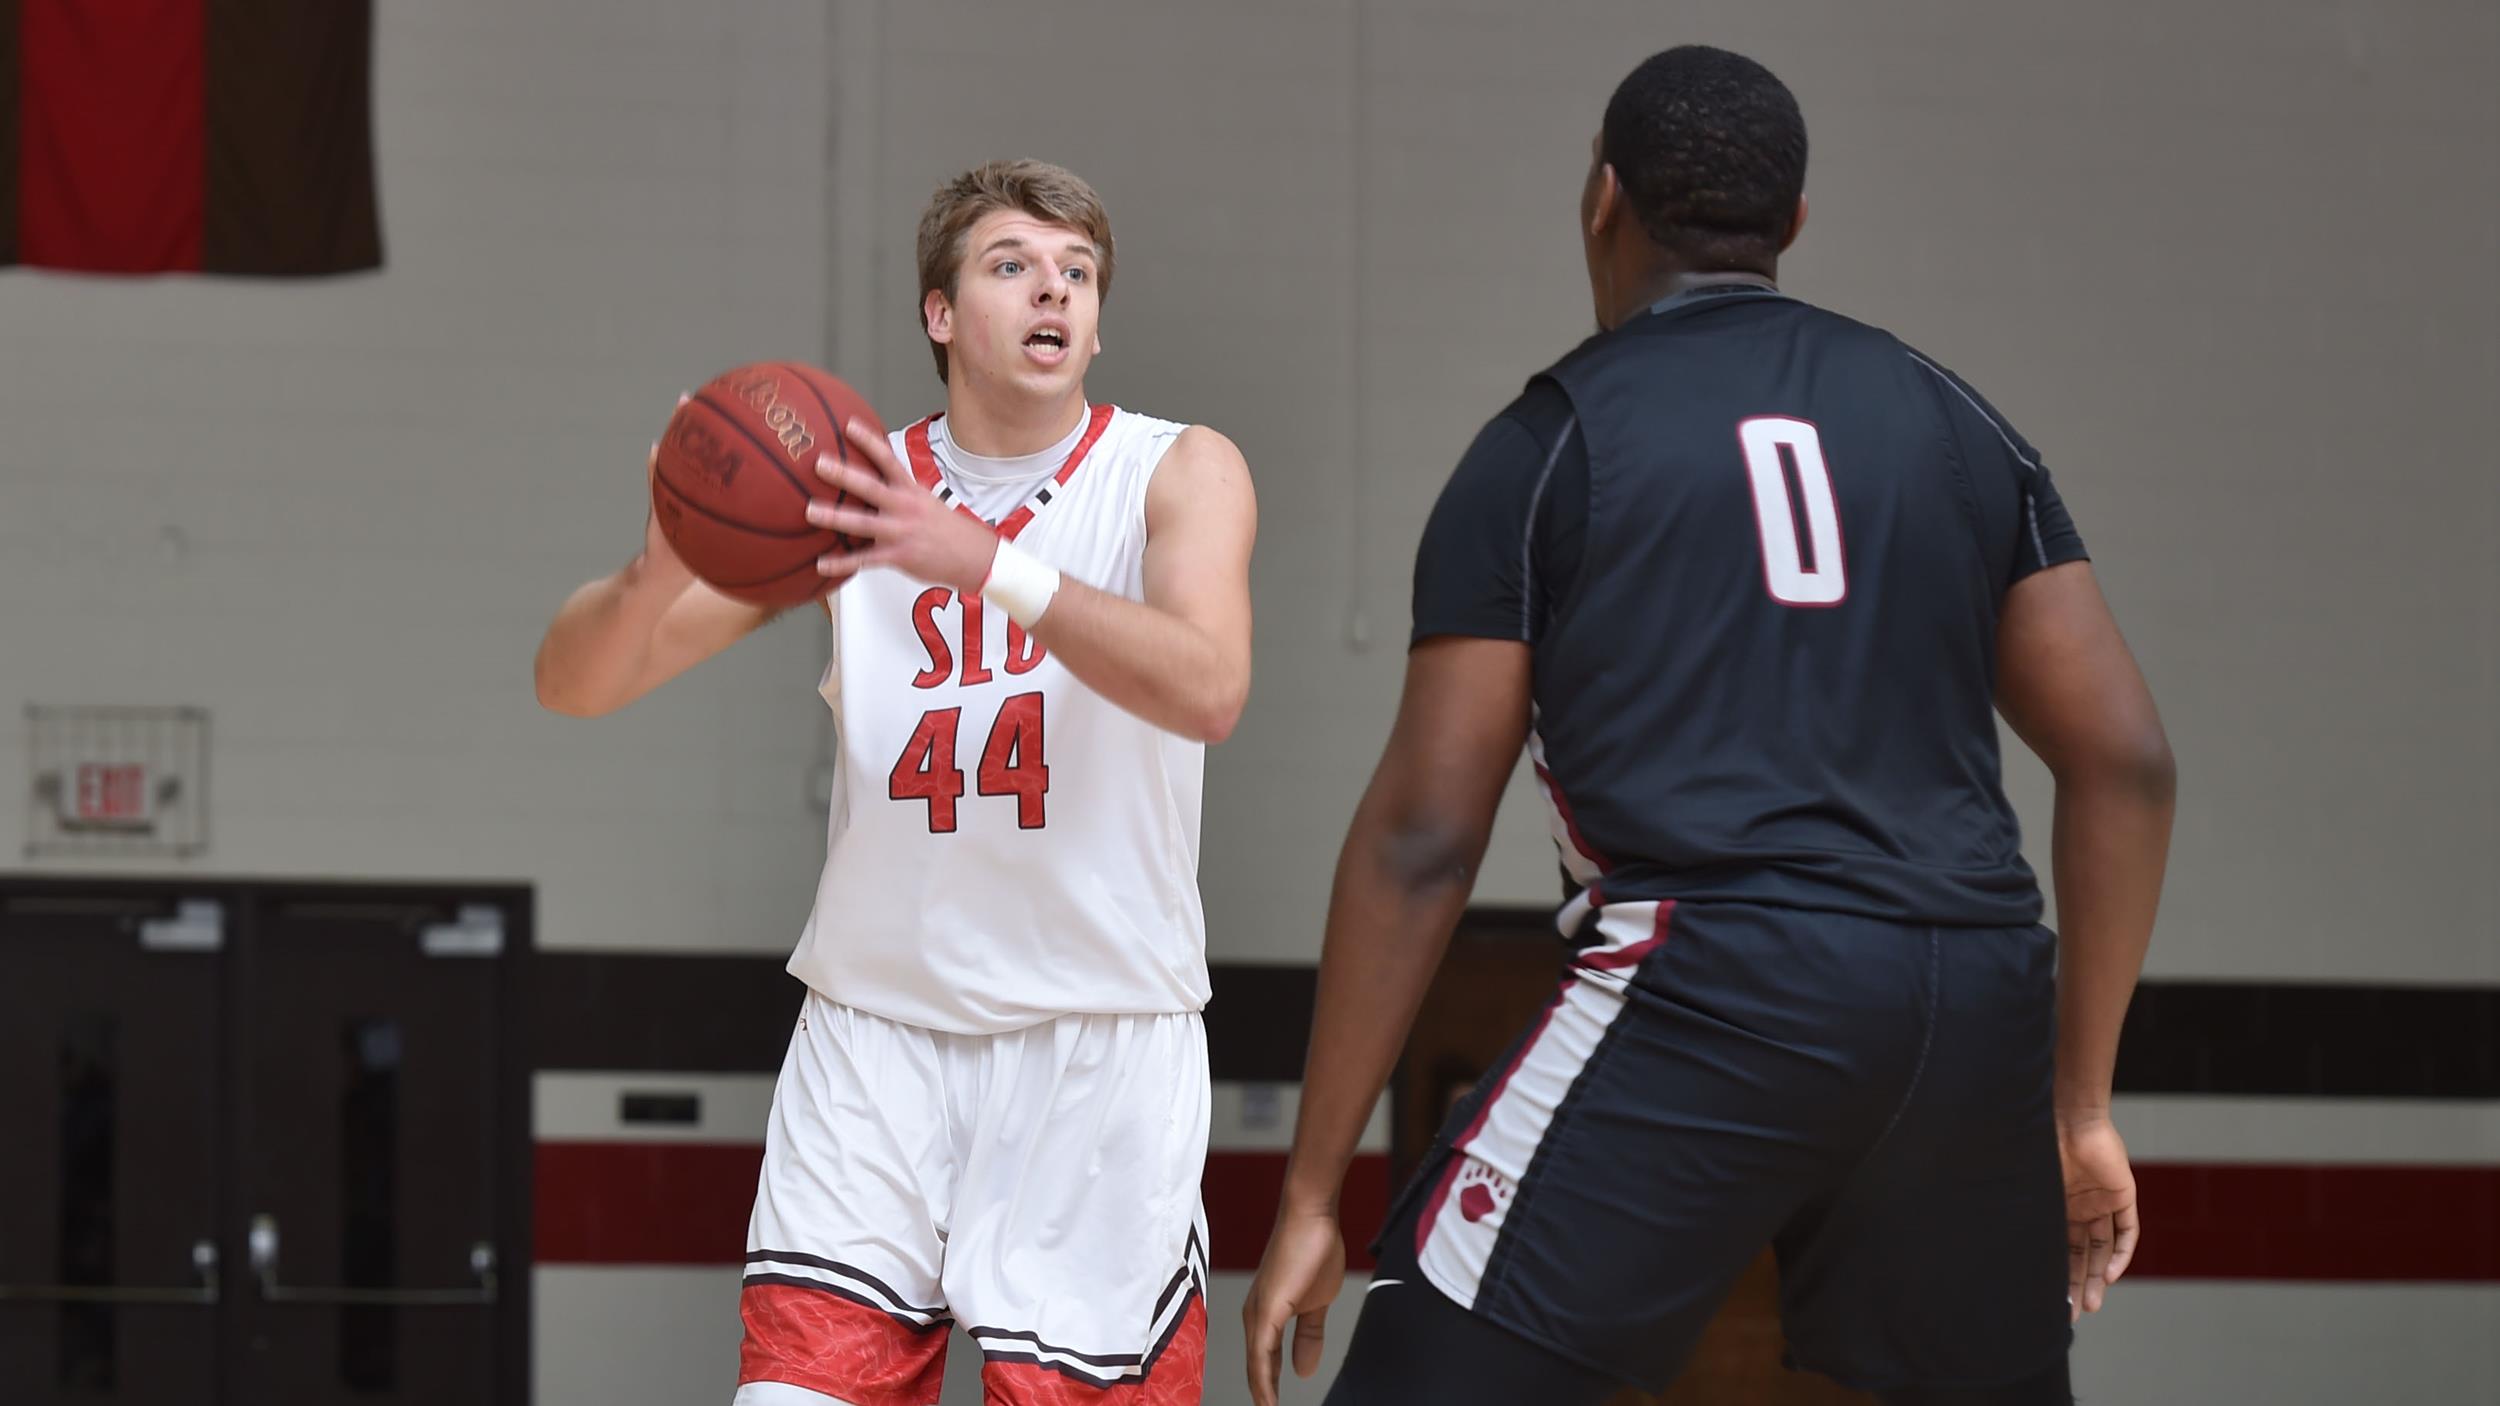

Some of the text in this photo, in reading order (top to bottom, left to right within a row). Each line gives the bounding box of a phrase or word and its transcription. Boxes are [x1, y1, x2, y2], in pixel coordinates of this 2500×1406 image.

[1735, 414, 1850, 608] 0
[76, 762, 145, 818] EXIT
[888, 691, 1050, 834] 44
